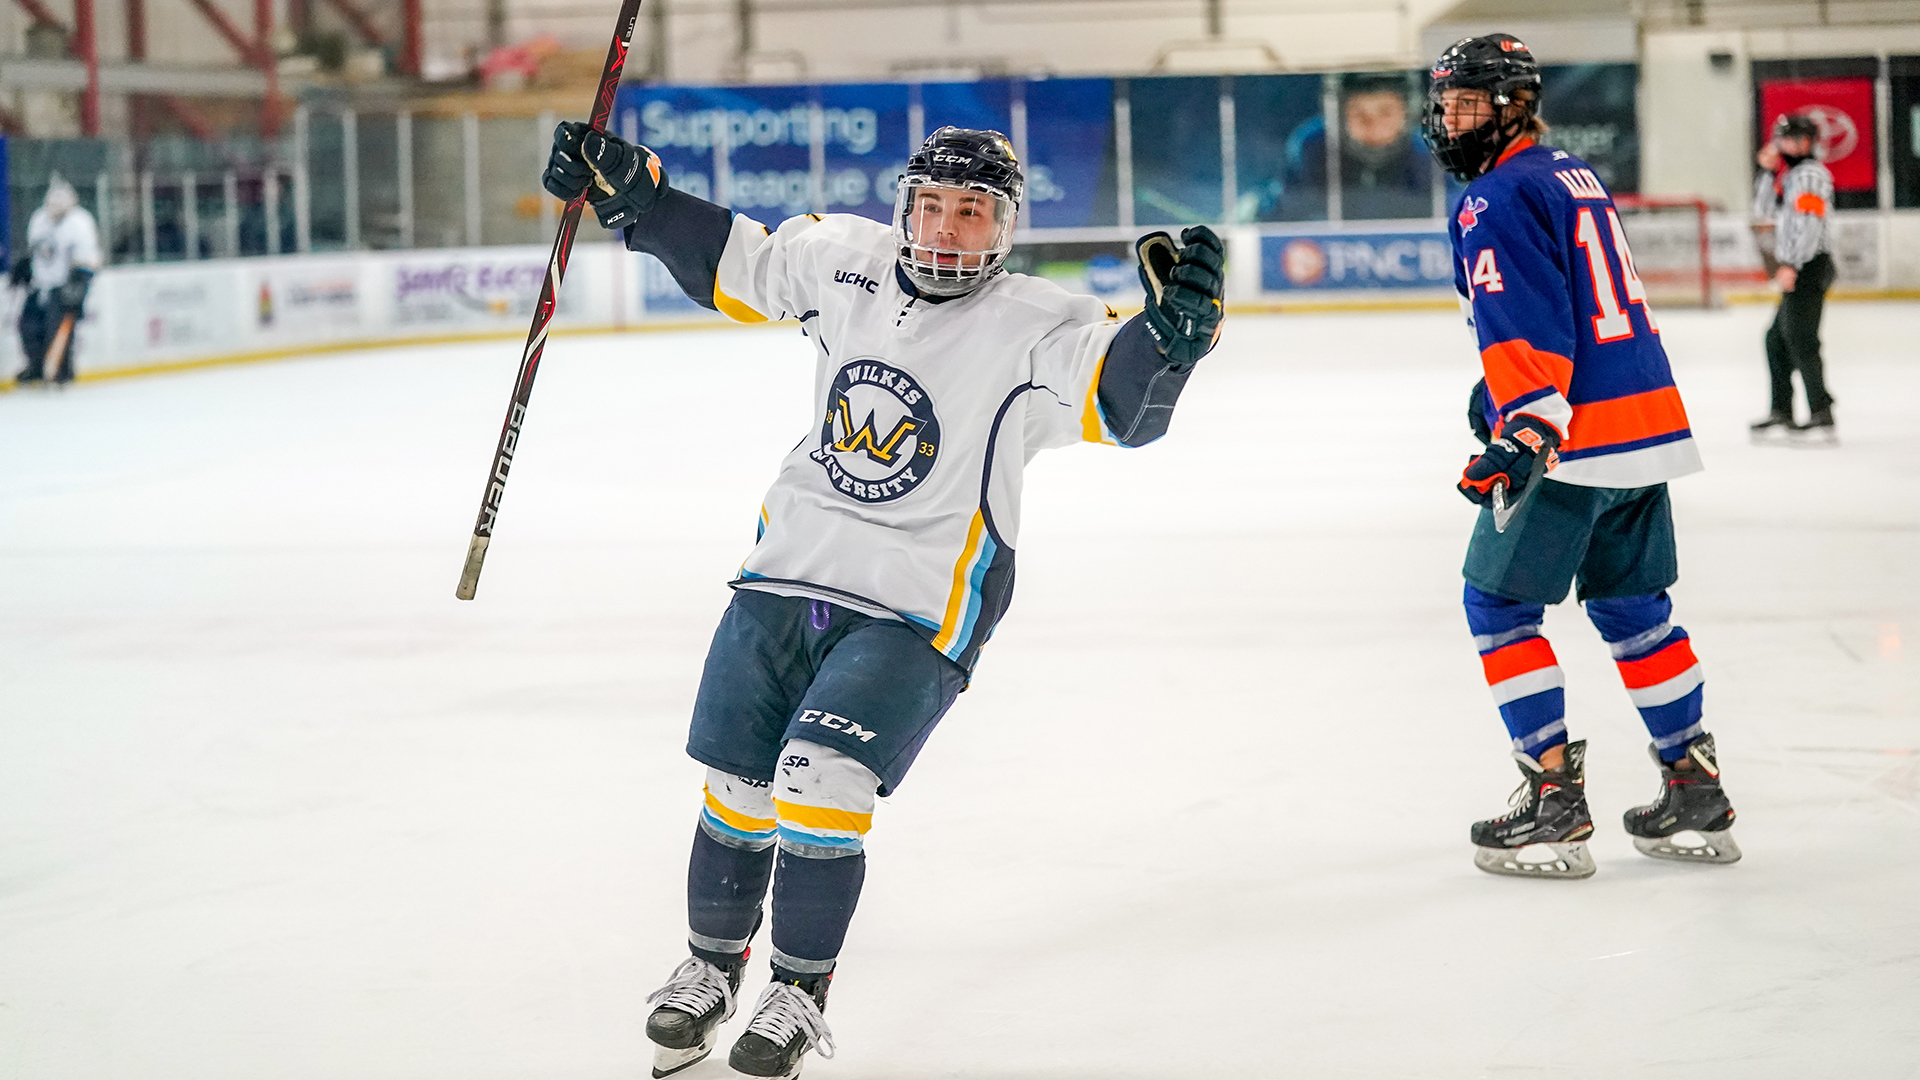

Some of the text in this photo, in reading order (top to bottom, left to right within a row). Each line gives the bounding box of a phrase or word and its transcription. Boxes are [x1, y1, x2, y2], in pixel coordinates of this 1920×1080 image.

[625, 16, 636, 38] LITE
[641, 100, 878, 154] Supporting
[932, 153, 973, 165] CCM
[1574, 207, 1660, 344] 14
[846, 365, 922, 405] WILKES
[479, 401, 526, 535] BAUER
[918, 441, 935, 457] 33
[811, 444, 918, 499] NIVERSITY
[798, 709, 878, 743] CCM
